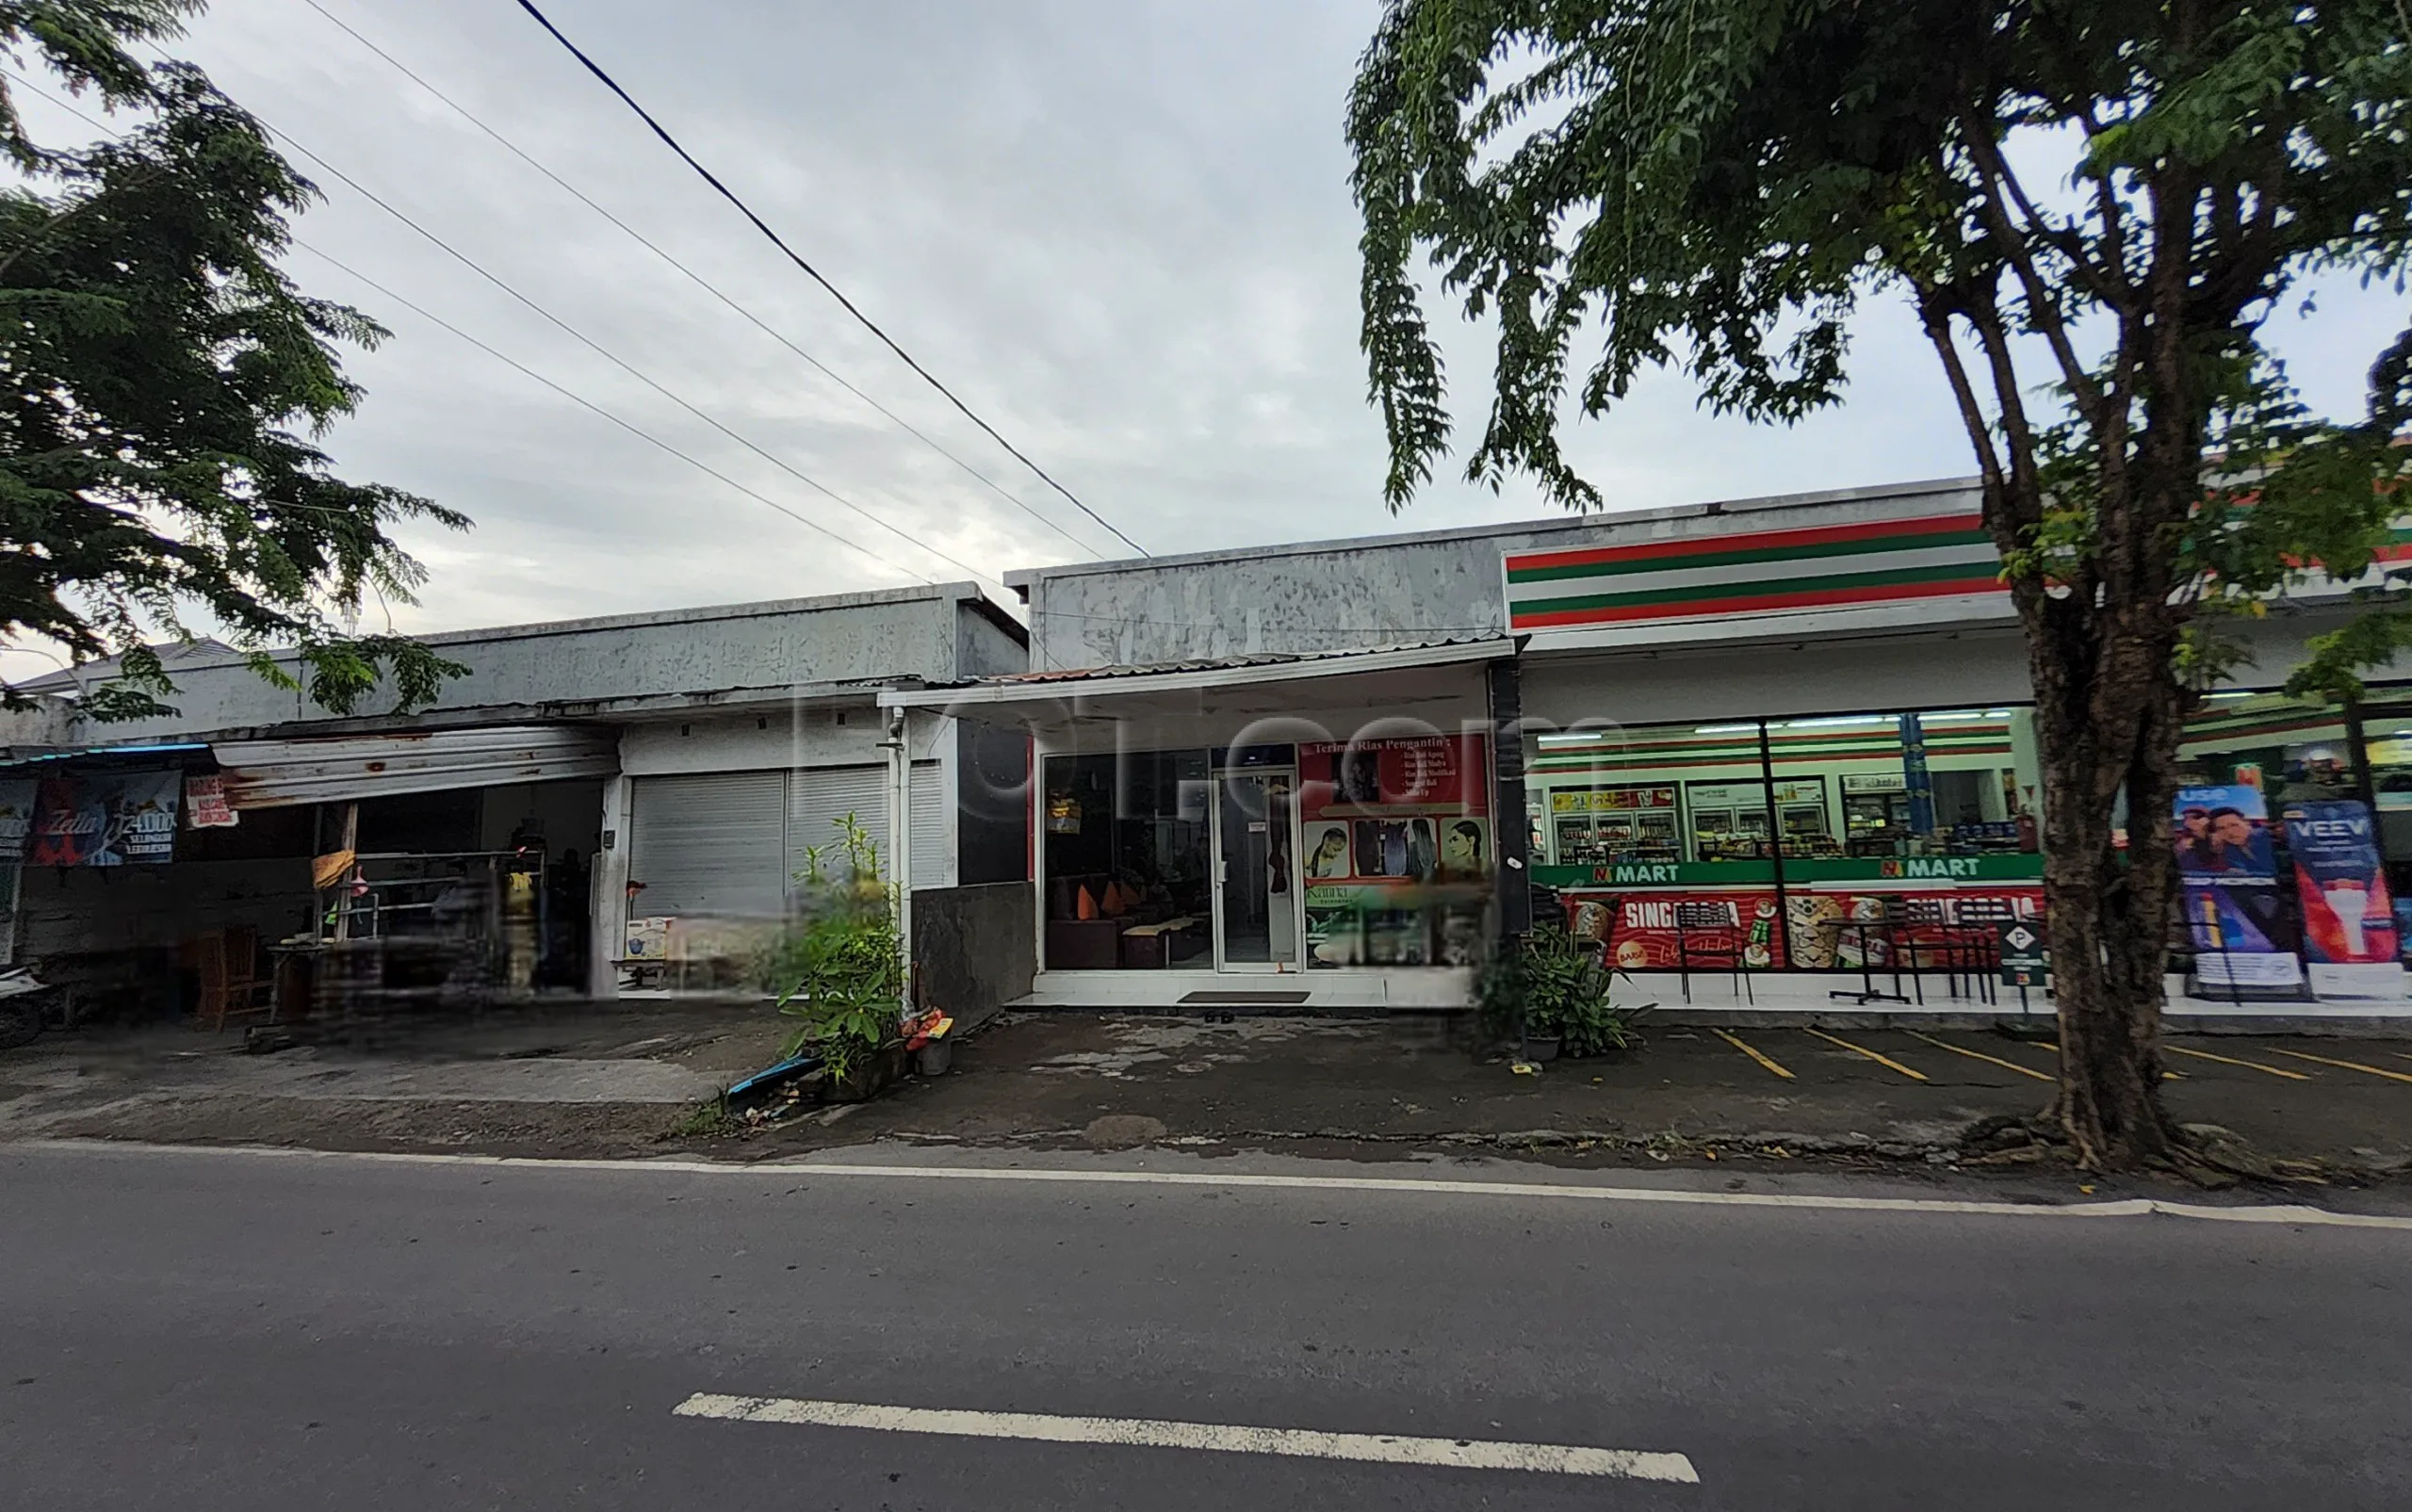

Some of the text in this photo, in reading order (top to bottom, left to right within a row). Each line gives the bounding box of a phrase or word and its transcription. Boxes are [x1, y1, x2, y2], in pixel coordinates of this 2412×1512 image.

[1314, 741, 1355, 755] Terima
[1358, 740, 1384, 752] Rias
[1386, 738, 1444, 751] Pengantin
[1615, 864, 1680, 883] MART
[1906, 857, 1981, 877] MART
[2014, 931, 2027, 945] P
